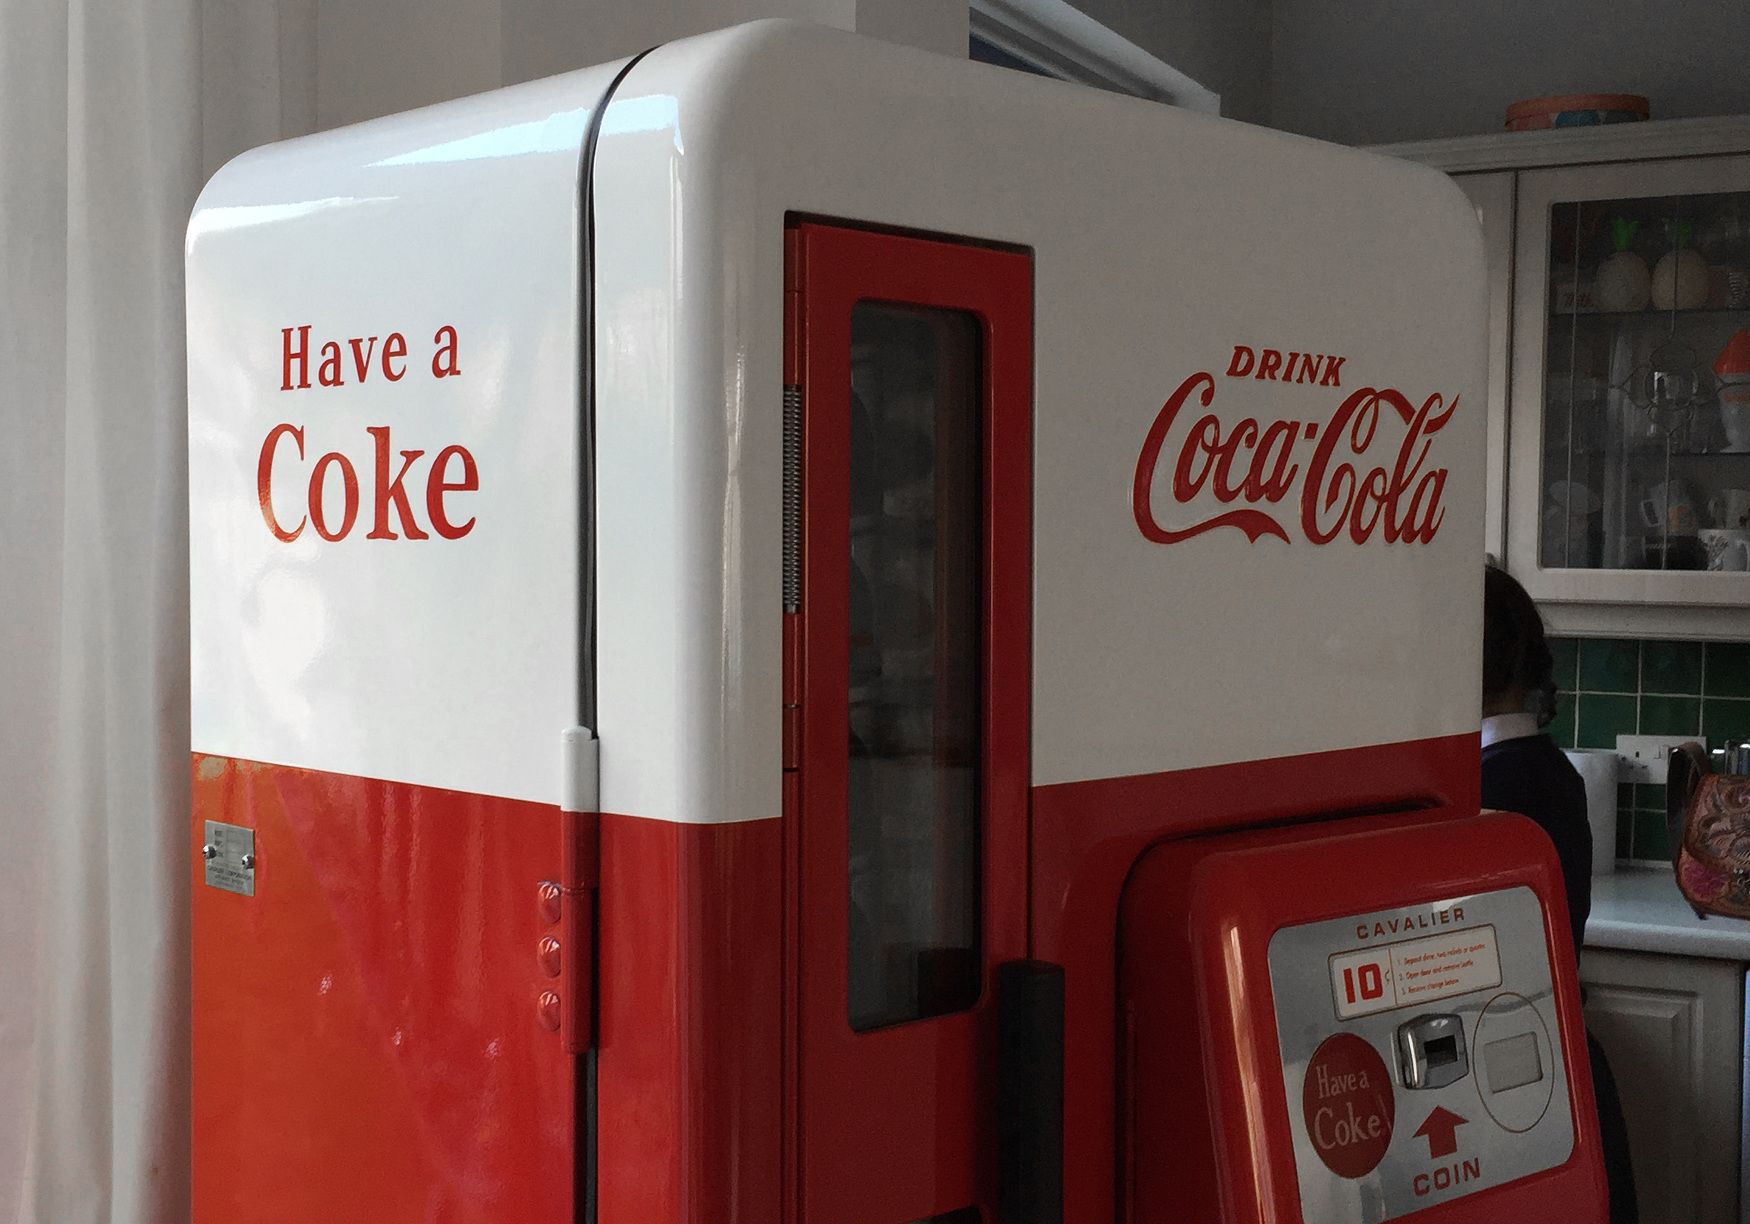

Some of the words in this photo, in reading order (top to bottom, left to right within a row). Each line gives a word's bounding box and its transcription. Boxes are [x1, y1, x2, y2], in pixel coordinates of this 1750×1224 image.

[280, 324, 408, 391] Have
[431, 324, 462, 379] a
[1226, 345, 1346, 387] DRINK
[1132, 372, 1460, 546] Coca-Cola
[257, 422, 480, 544] Coke
[1356, 907, 1465, 940] CAVALIER
[1316, 1063, 1358, 1100] Have
[1359, 1070, 1370, 1089] a
[1314, 1101, 1381, 1150] Coke
[1413, 1157, 1481, 1198] COIN
